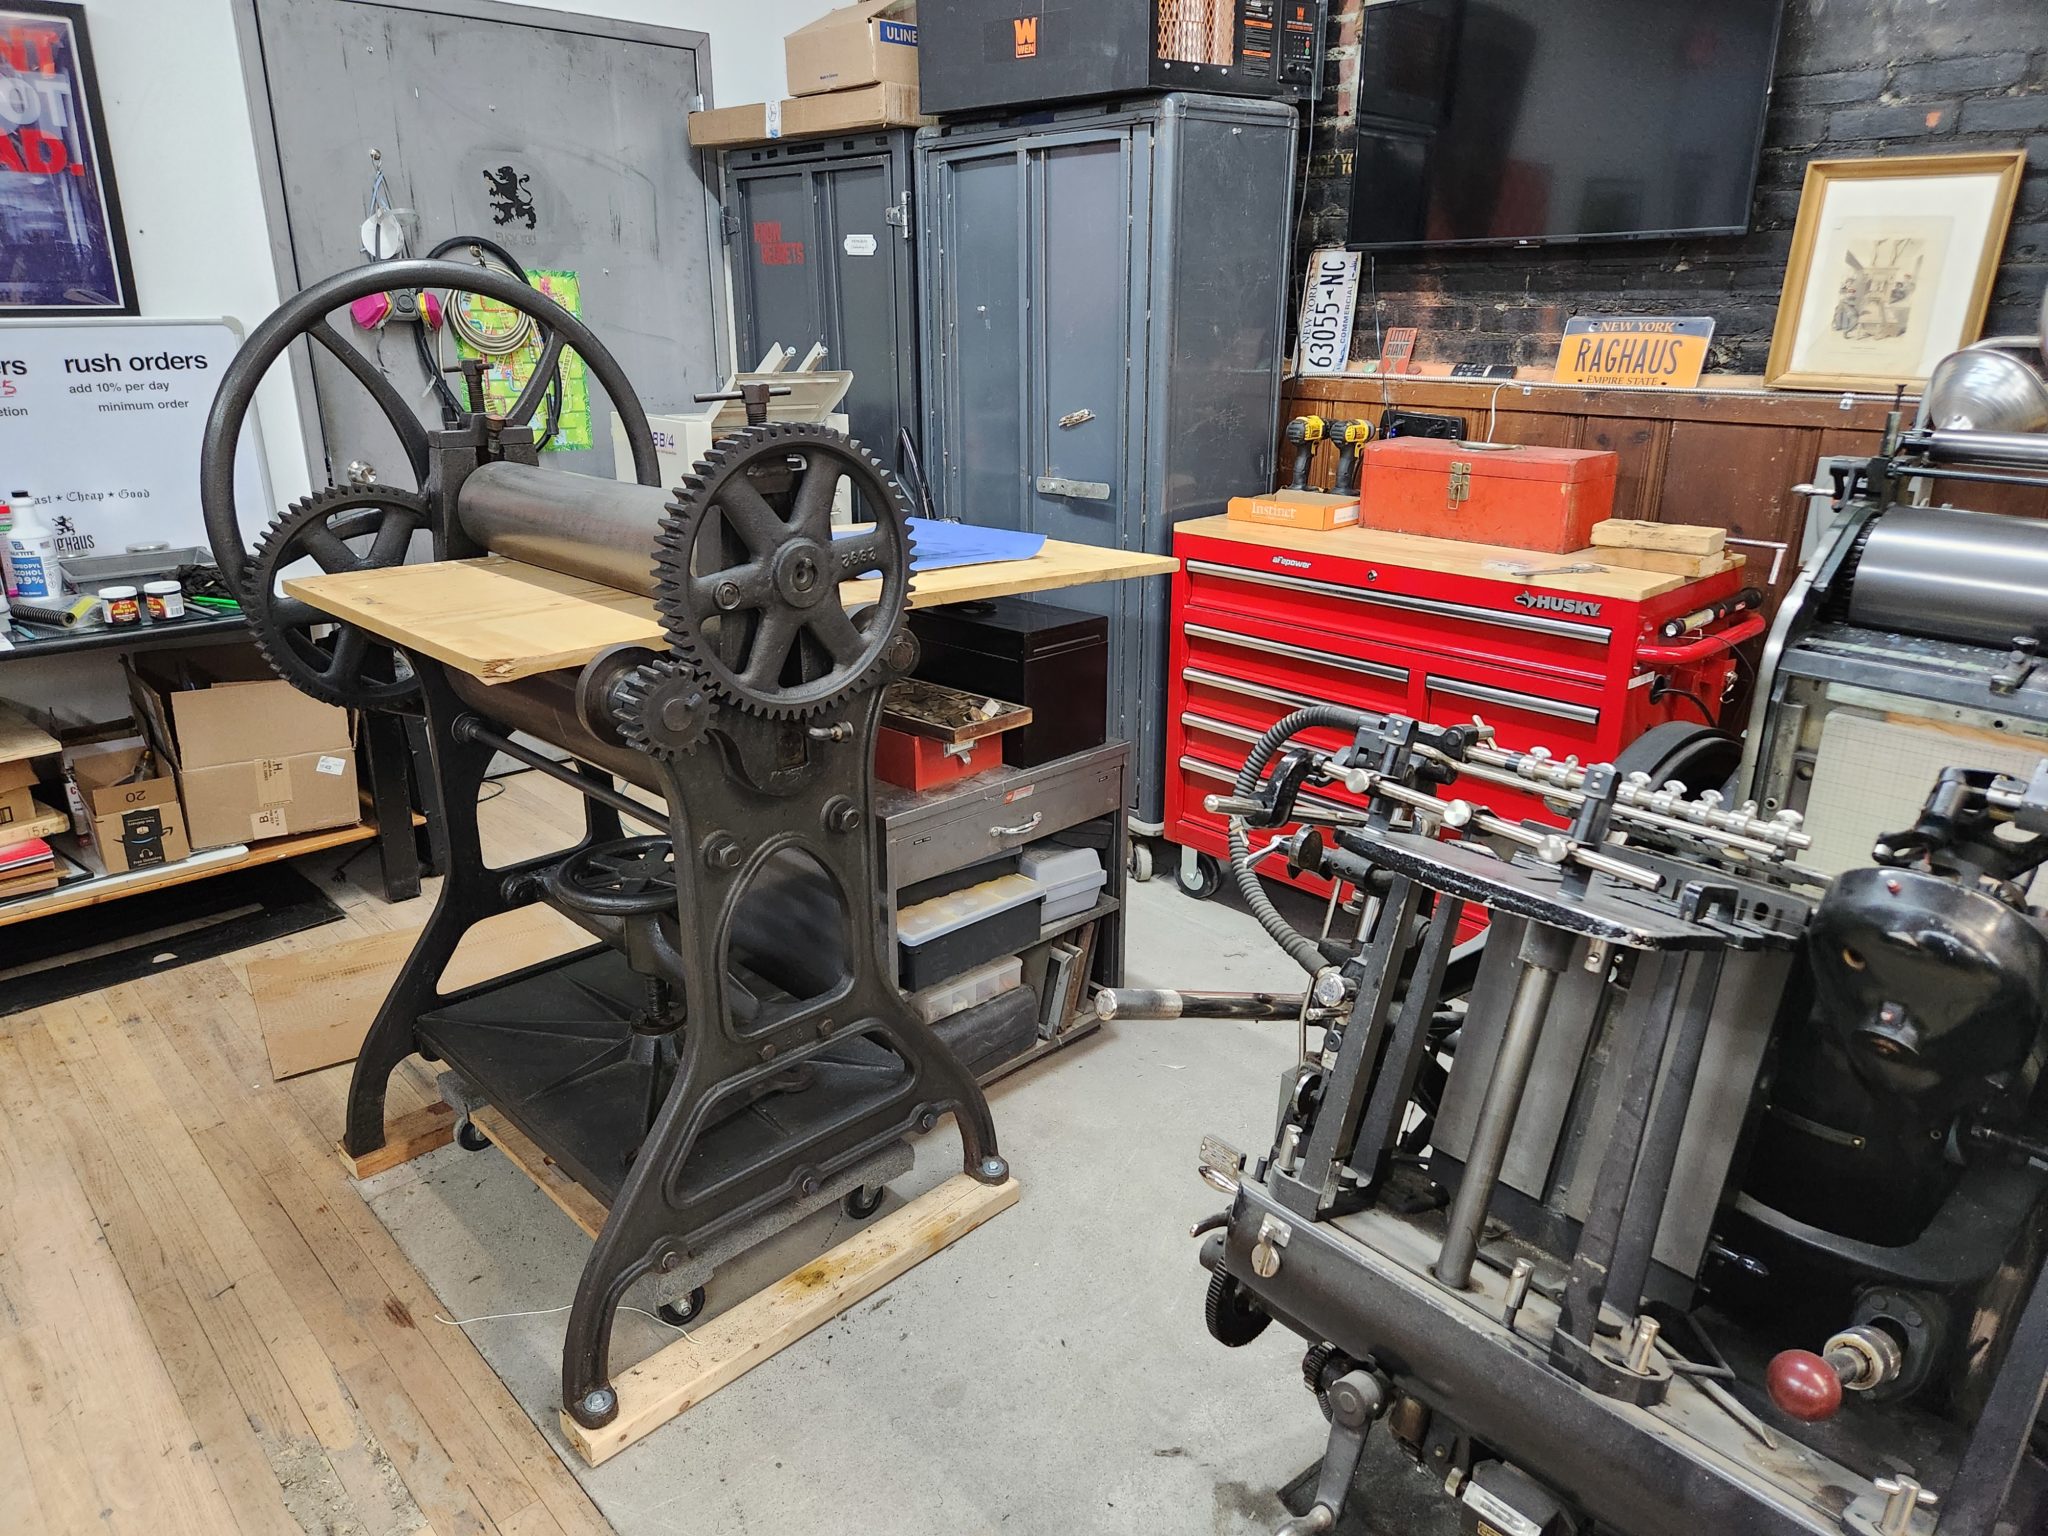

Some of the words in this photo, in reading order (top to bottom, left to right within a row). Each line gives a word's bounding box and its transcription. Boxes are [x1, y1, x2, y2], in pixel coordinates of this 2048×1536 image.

[886, 26, 918, 43] ULINE
[1320, 261, 1346, 286] NC
[1306, 283, 1318, 315] YORK
[1340, 285, 1354, 344] COMMERCIAL
[1302, 318, 1312, 344] NEW
[1309, 303, 1340, 368] 63055
[1600, 322, 1632, 332] NEW
[1638, 322, 1675, 333] YORK
[0, 360, 28, 375] rs
[64, 353, 122, 373] rush
[129, 352, 208, 371] orders
[1574, 338, 1683, 375] RAGHAUS
[69, 384, 92, 394] add
[96, 382, 121, 392] 10%
[125, 383, 145, 393] per
[148, 381, 170, 392] day
[1586, 375, 1624, 385] EMPIRE
[1627, 377, 1658, 386] STATE
[98, 401, 154, 412] minimum
[157, 400, 189, 409] order
[34, 495, 52, 505] ast
[66, 491, 104, 502] Cheap
[118, 489, 150, 499] Good
[1252, 501, 1296, 518] Instinct
[1536, 595, 1601, 616] HUSKY
